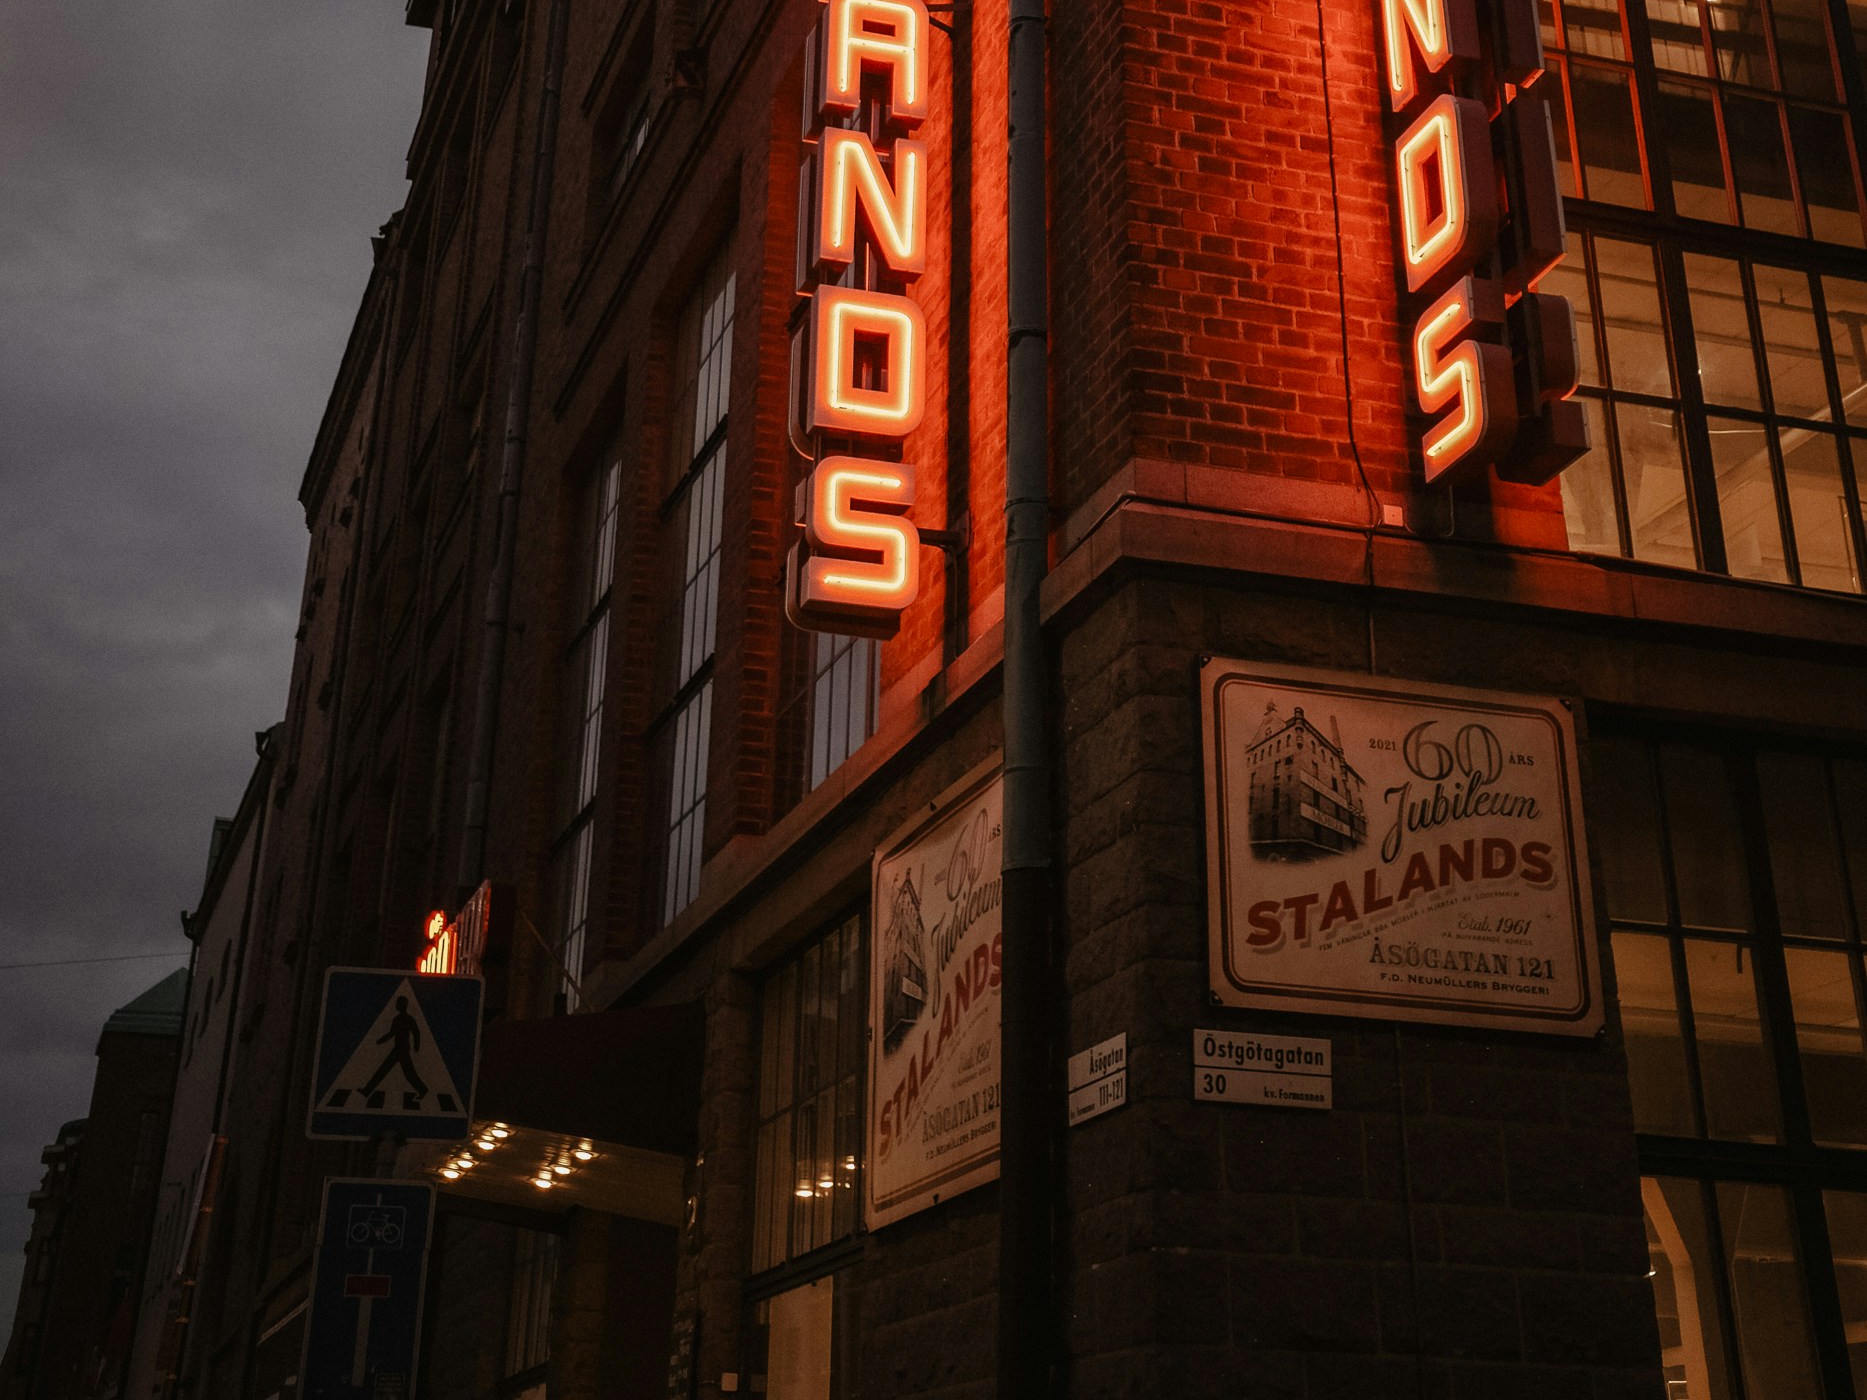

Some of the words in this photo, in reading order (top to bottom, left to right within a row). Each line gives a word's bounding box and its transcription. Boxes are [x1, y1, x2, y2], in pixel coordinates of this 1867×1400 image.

[1368, 738, 1397, 751] 2021
[1403, 720, 1503, 785] 60
[1508, 751, 1534, 766] ÅRS
[1381, 770, 1540, 863] Jubileum
[1246, 838, 1555, 948] STALANDS
[1496, 916, 1532, 936] 1961
[1369, 937, 1508, 975] ÅSÖGATAN
[1518, 956, 1555, 980] 121
[1381, 973, 1403, 983] F.D.
[880, 932, 1002, 1156] STALANDS
[1203, 1033, 1324, 1069] Östgötagatan
[1089, 1048, 1123, 1075] Åsögatan
[982, 1082, 1000, 1114] 121
[1099, 1077, 1124, 1107] 111-121
[1203, 1073, 1226, 1094] 30
